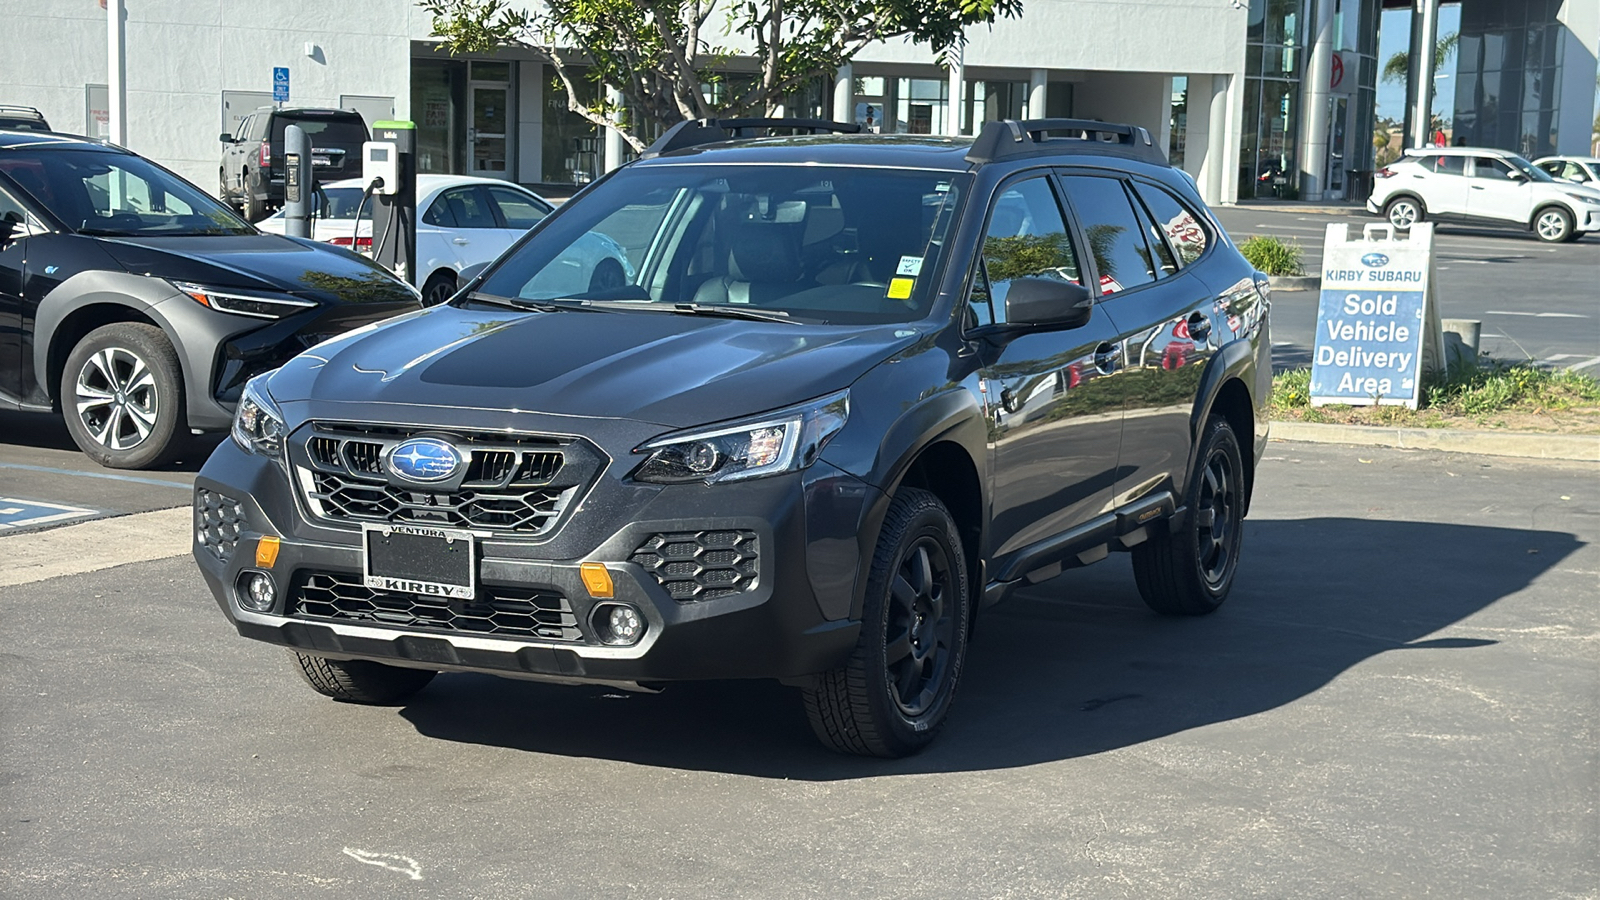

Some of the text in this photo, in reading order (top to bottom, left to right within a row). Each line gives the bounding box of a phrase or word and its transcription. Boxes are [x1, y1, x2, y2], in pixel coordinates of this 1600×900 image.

[1325, 269, 1422, 282] KIRBY SUBARU
[1343, 293, 1398, 316] Sold
[1326, 319, 1410, 342] Vehicle
[1317, 345, 1413, 372] Delivery
[1337, 372, 1392, 394] Area
[390, 525, 447, 538] VENTURA
[385, 579, 455, 596] KIRBY
